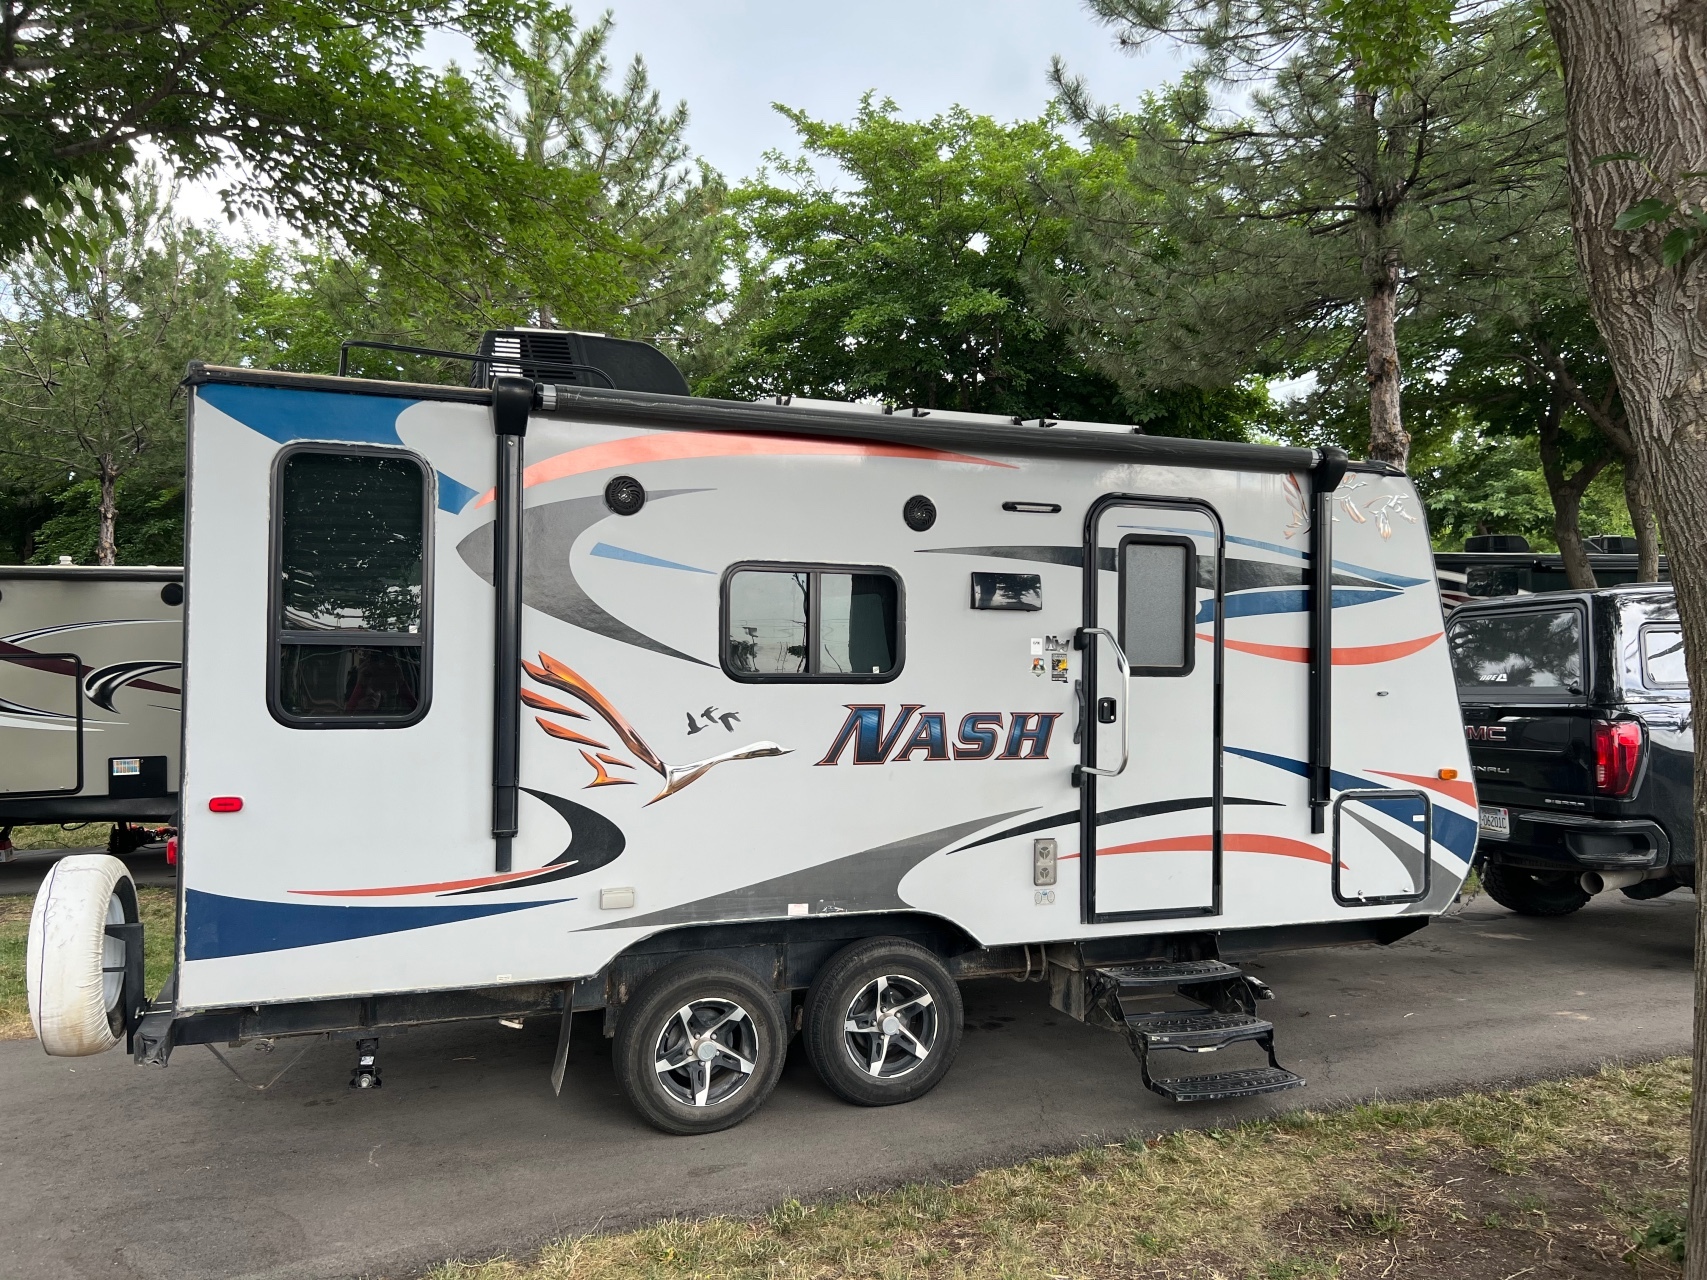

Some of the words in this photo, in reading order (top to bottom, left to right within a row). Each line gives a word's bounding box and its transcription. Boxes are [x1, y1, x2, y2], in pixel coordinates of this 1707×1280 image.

[813, 704, 1064, 766] NASH
[1464, 725, 1507, 742] MC
[1471, 765, 1510, 774] ENALI
